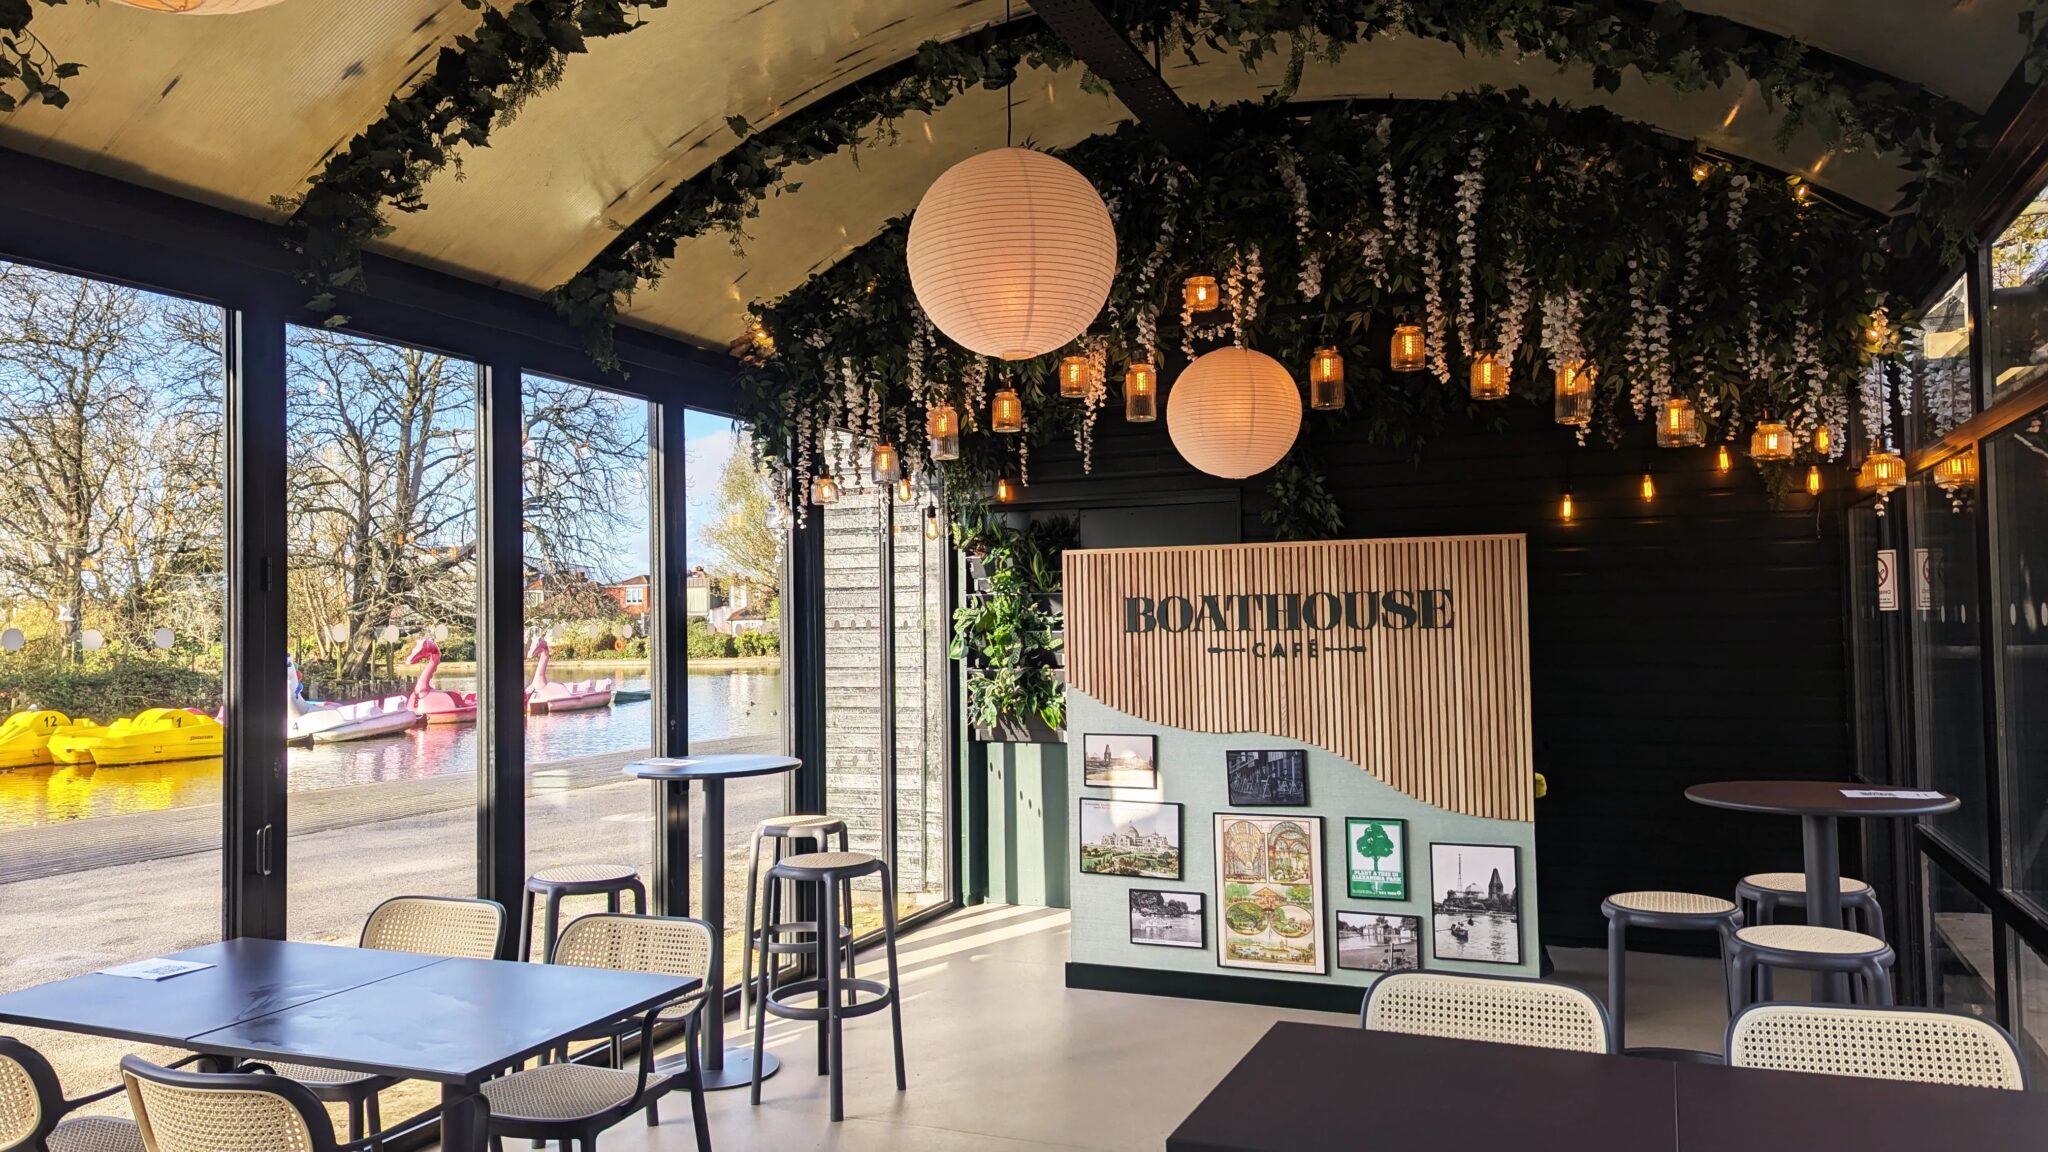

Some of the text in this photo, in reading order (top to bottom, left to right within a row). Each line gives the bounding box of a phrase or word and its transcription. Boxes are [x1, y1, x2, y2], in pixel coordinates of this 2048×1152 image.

[1124, 588, 1455, 633] BOATHOUSE
[1252, 639, 1318, 658] CAFÉ
[44, 716, 58, 728] 12
[292, 722, 300, 732] 4
